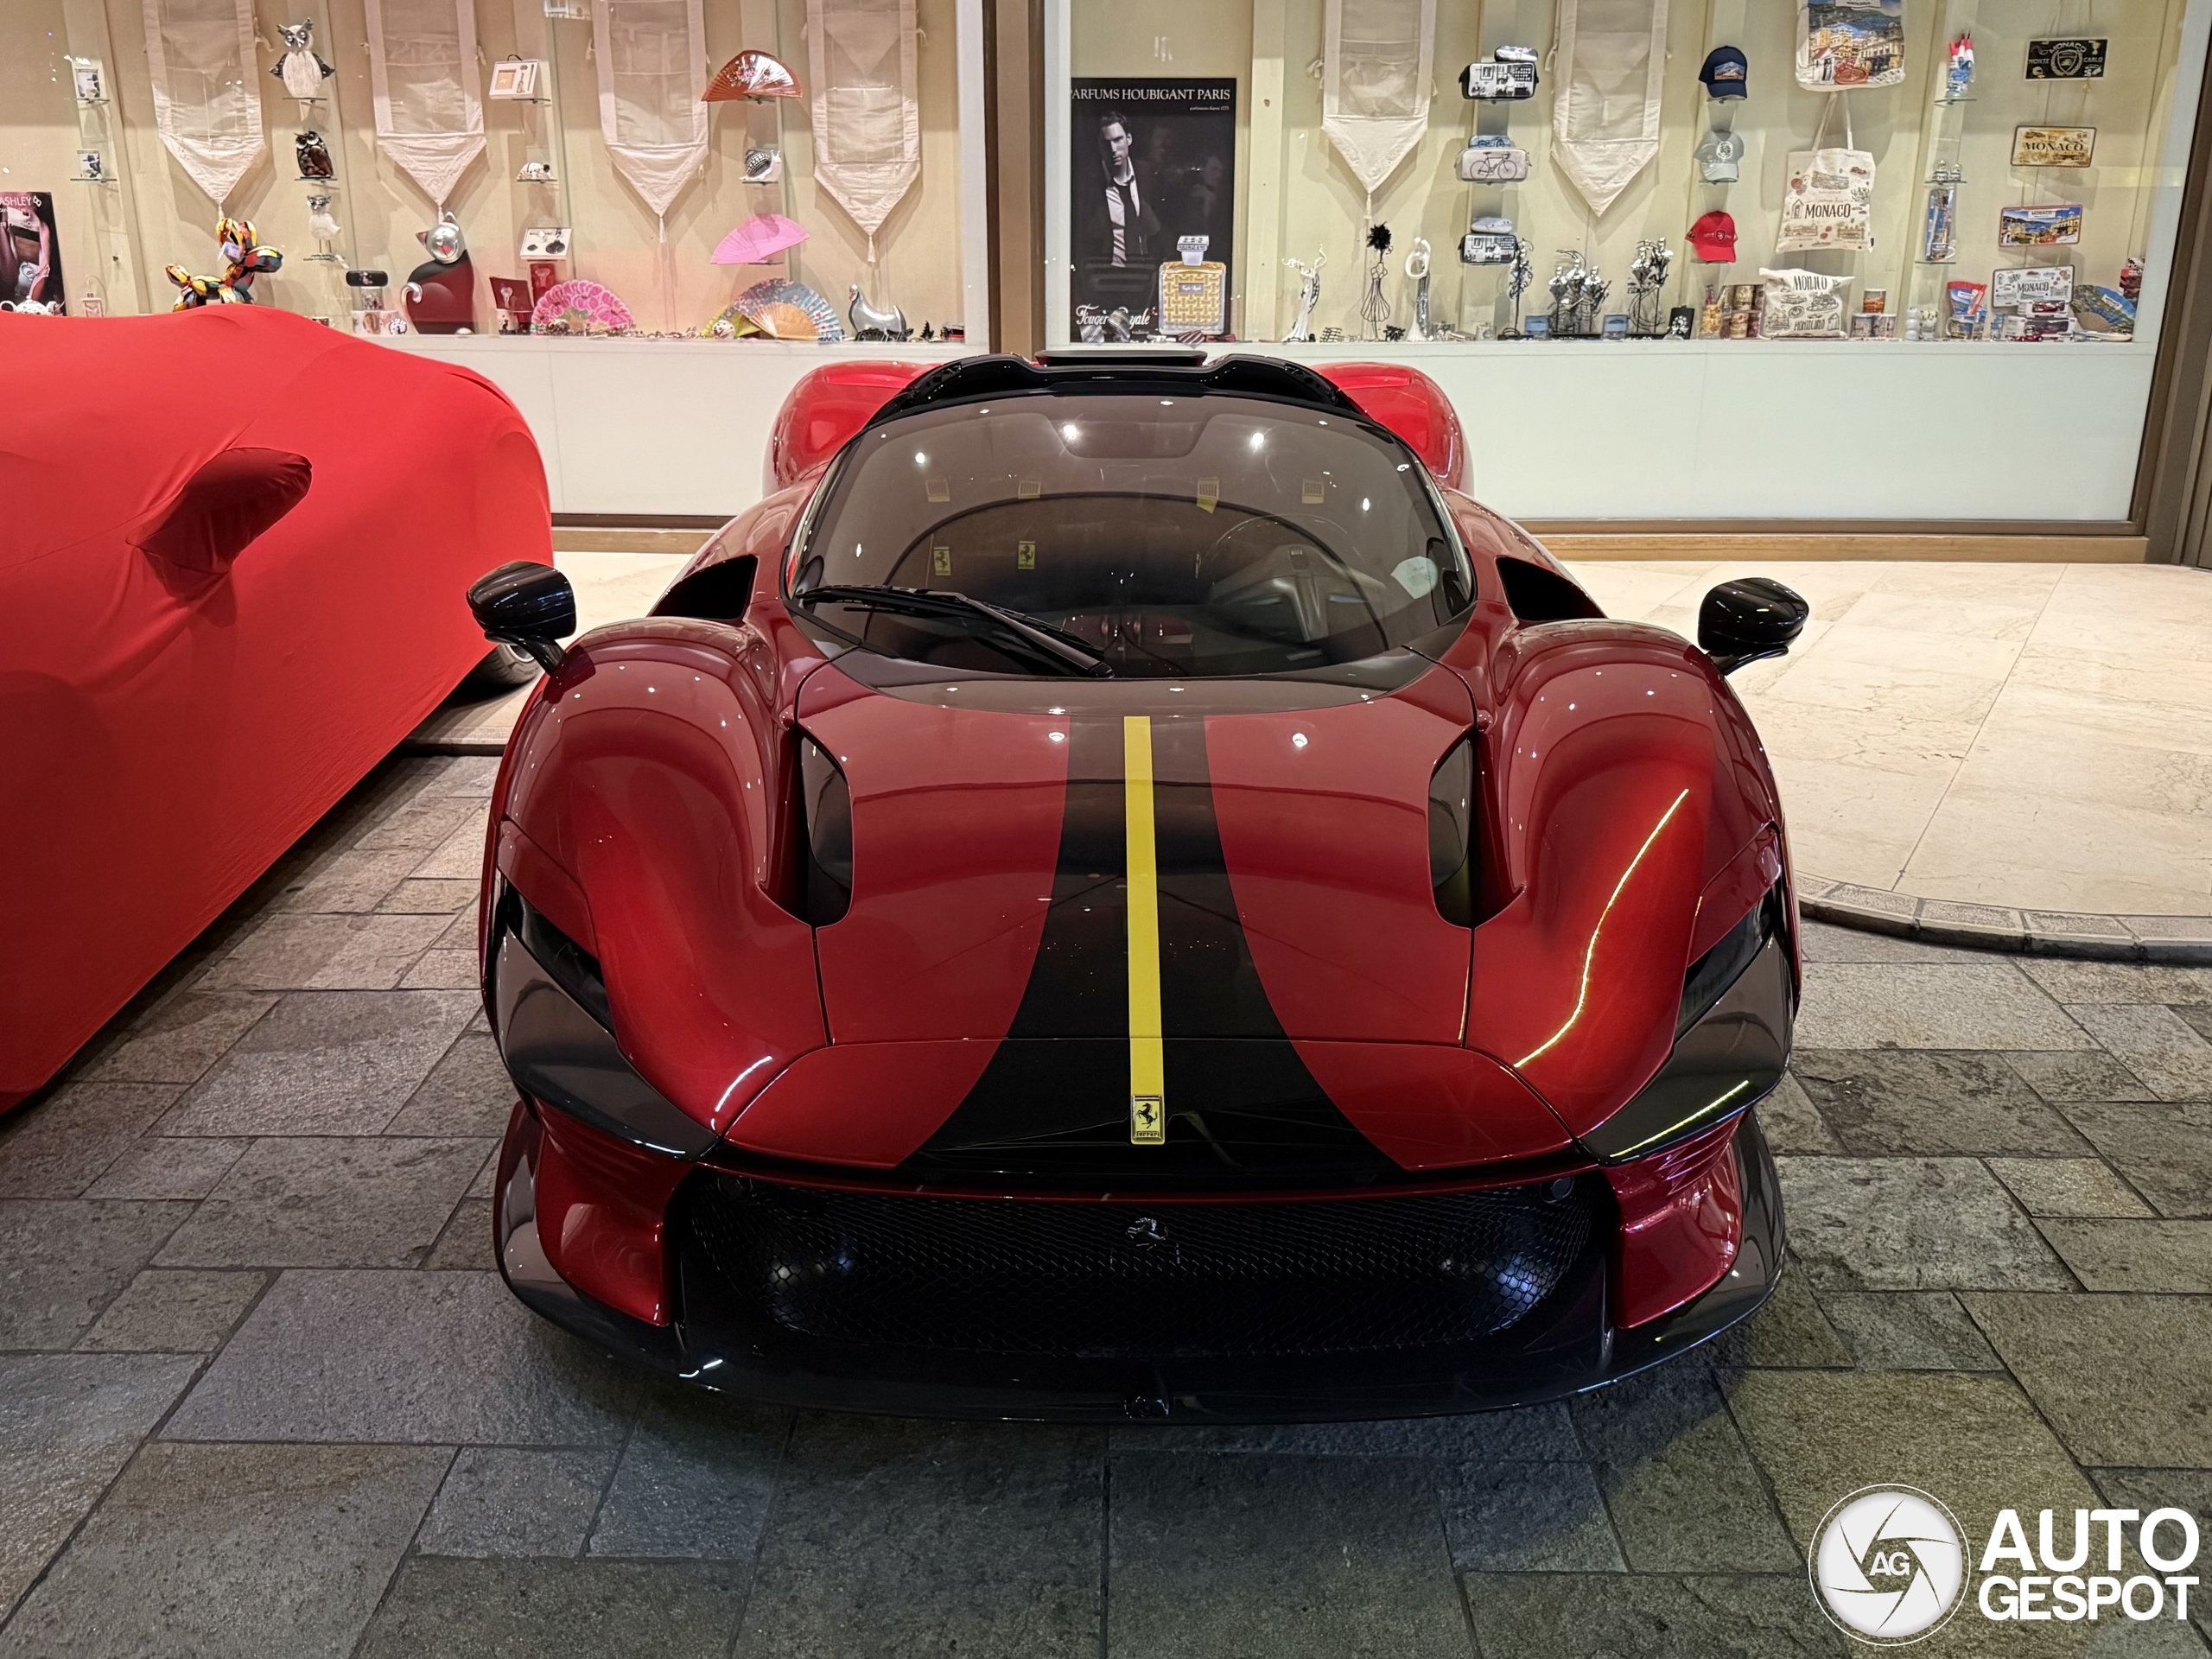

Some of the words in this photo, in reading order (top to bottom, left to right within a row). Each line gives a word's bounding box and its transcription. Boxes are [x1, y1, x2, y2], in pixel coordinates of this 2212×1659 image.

[2049, 41, 2087, 54] MONACO
[1122, 89, 1195, 99] HOUBIGANT
[1197, 89, 1230, 99] PARIS
[2024, 142, 2083, 151] MONACO
[1804, 203, 1851, 219] MONACO
[2017, 282, 2050, 293] MONACO
